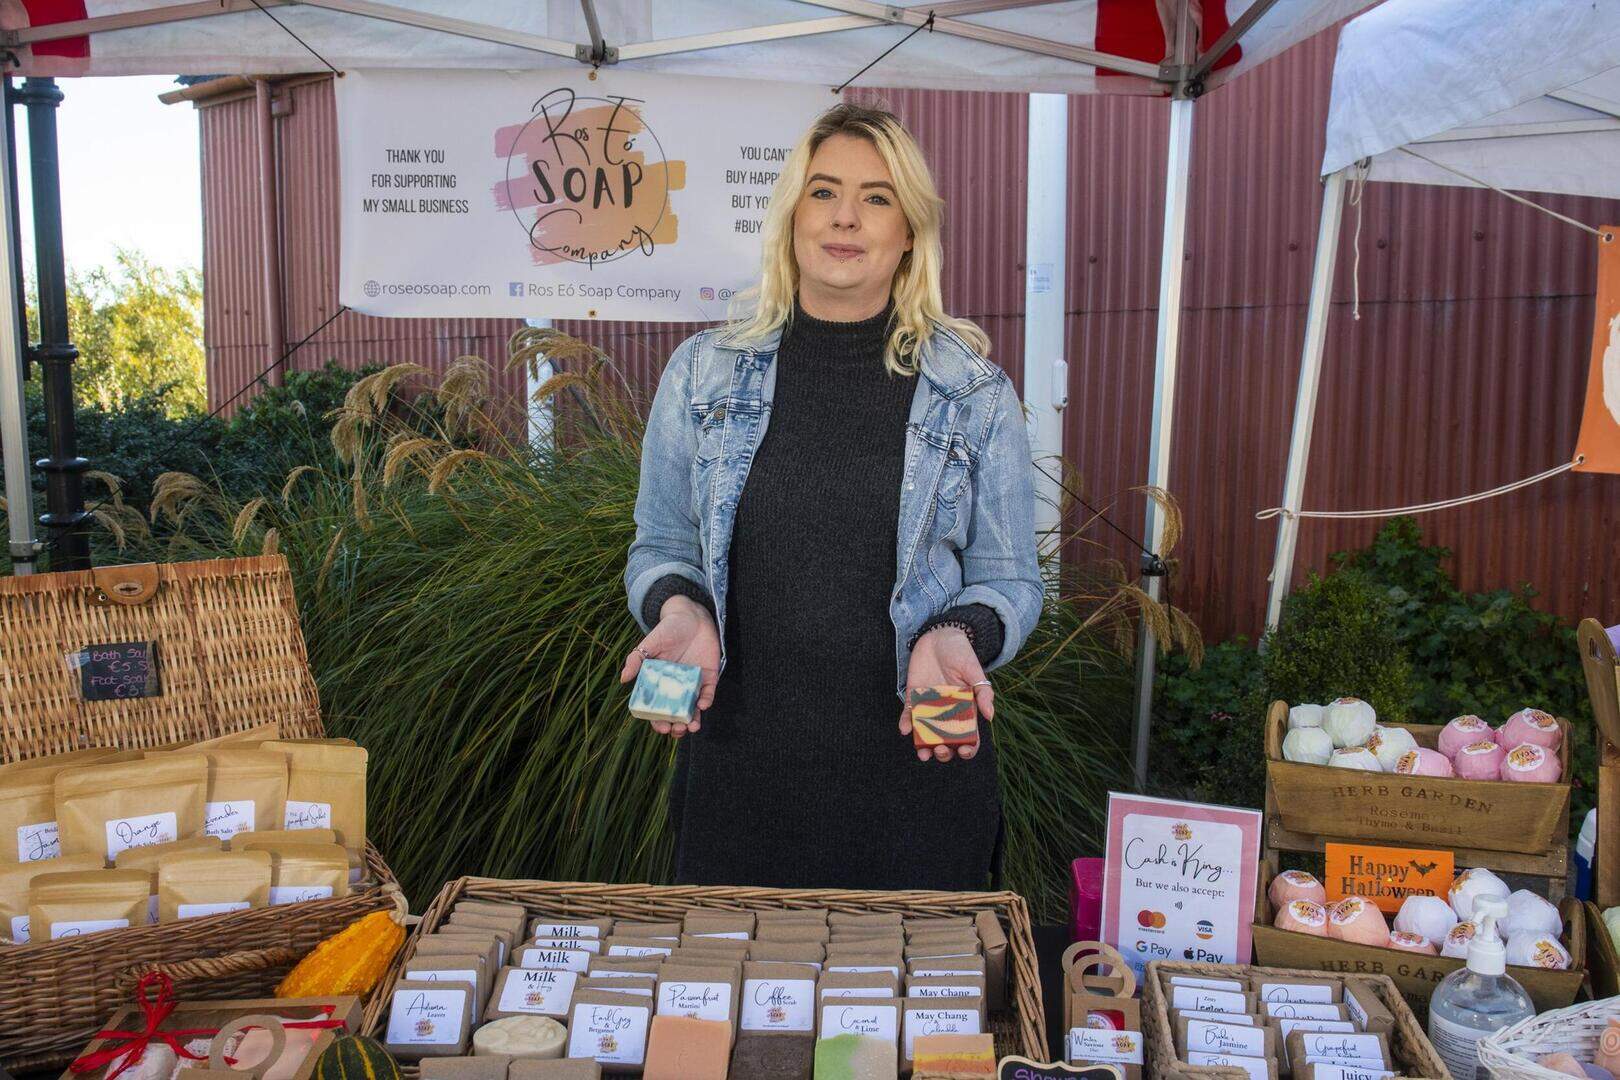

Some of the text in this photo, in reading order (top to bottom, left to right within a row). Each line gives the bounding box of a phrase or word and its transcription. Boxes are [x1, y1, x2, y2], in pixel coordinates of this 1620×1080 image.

[532, 88, 590, 165] Ros
[385, 149, 445, 163] THANK YOU
[740, 146, 761, 160] YOU
[371, 174, 457, 188] FOR SUPPORTING
[532, 159, 643, 209] SOAP
[726, 170, 747, 184] BUY
[363, 199, 469, 213] MY SMALL BUSINESS
[731, 195, 752, 208] BUT
[735, 219, 763, 233] #BUY
[529, 208, 655, 271] Company
[382, 283, 491, 297] roseosoap.com
[528, 283, 681, 301] Ros Eó Soap Company
[1332, 785, 1496, 814] HERB GARDEN
[116, 820, 161, 844] Orange
[1125, 837, 1168, 870] Cash
[1171, 859, 1177, 867] is
[1349, 855, 1409, 883] Happy
[1135, 878, 1152, 888] But
[1171, 882, 1189, 893] also
[1191, 887, 1225, 899] accept:
[1341, 877, 1436, 898] Halloween
[551, 926, 581, 938] Milk
[538, 951, 570, 963] Milk
[1150, 943, 1172, 958] Pay
[1320, 960, 1384, 973] HERB
[523, 972, 557, 983] Milk
[754, 982, 793, 1007] Coffee
[919, 988, 970, 997] May Chang
[915, 1012, 968, 1022] May Chang
[861, 1025, 880, 1033] Lime
[1218, 1040, 1248, 1049] Jasmine
